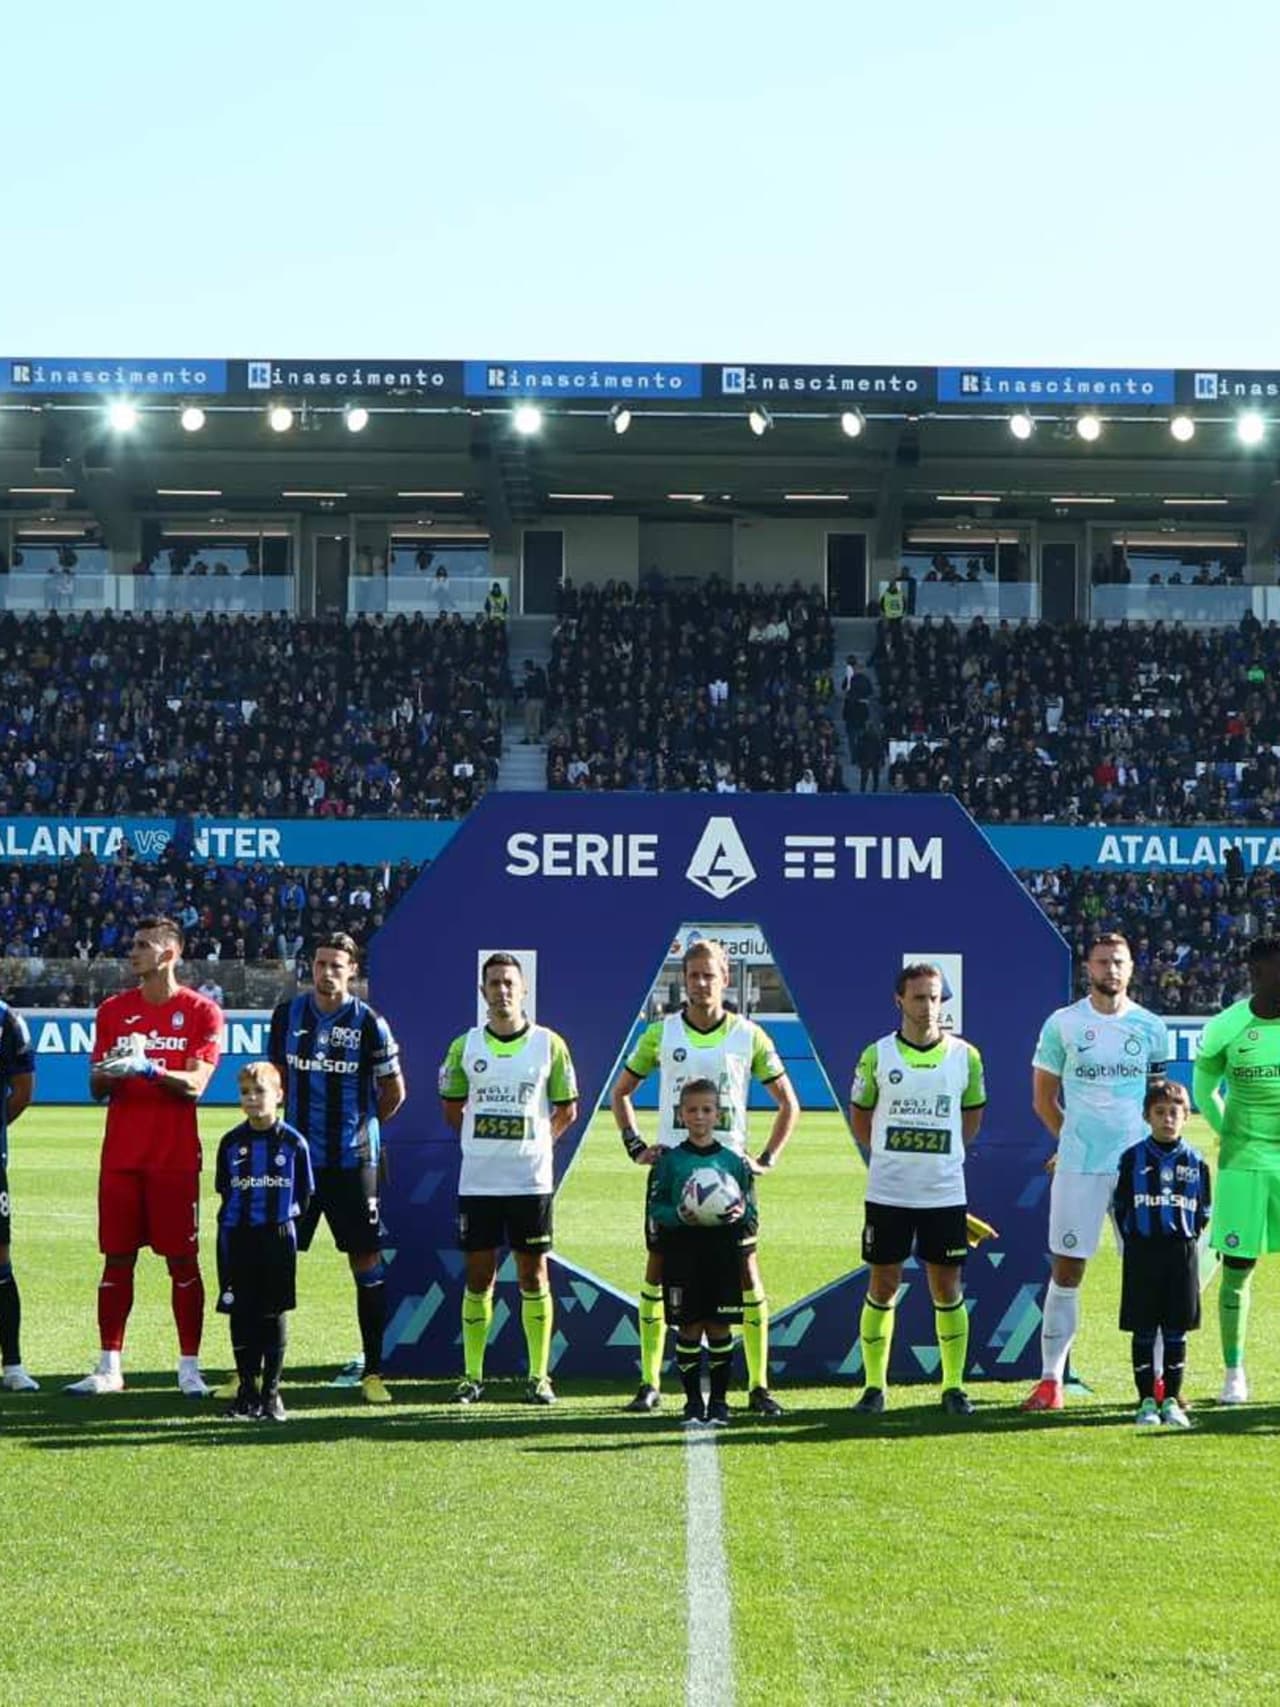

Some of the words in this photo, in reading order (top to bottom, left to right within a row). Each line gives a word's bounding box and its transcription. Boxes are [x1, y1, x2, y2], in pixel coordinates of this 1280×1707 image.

[12, 364, 208, 384] Rinascimento
[248, 362, 445, 388] Rinascimento
[487, 368, 683, 390] Rinascimento
[723, 367, 919, 393] Rinascimento
[961, 373, 1155, 394] Rinascimento
[0, 826, 125, 856] LANTA
[133, 830, 171, 855] VS
[505, 832, 659, 877] SERIE
[844, 836, 943, 880] TIM
[230, 1175, 292, 1191] digitalbits
